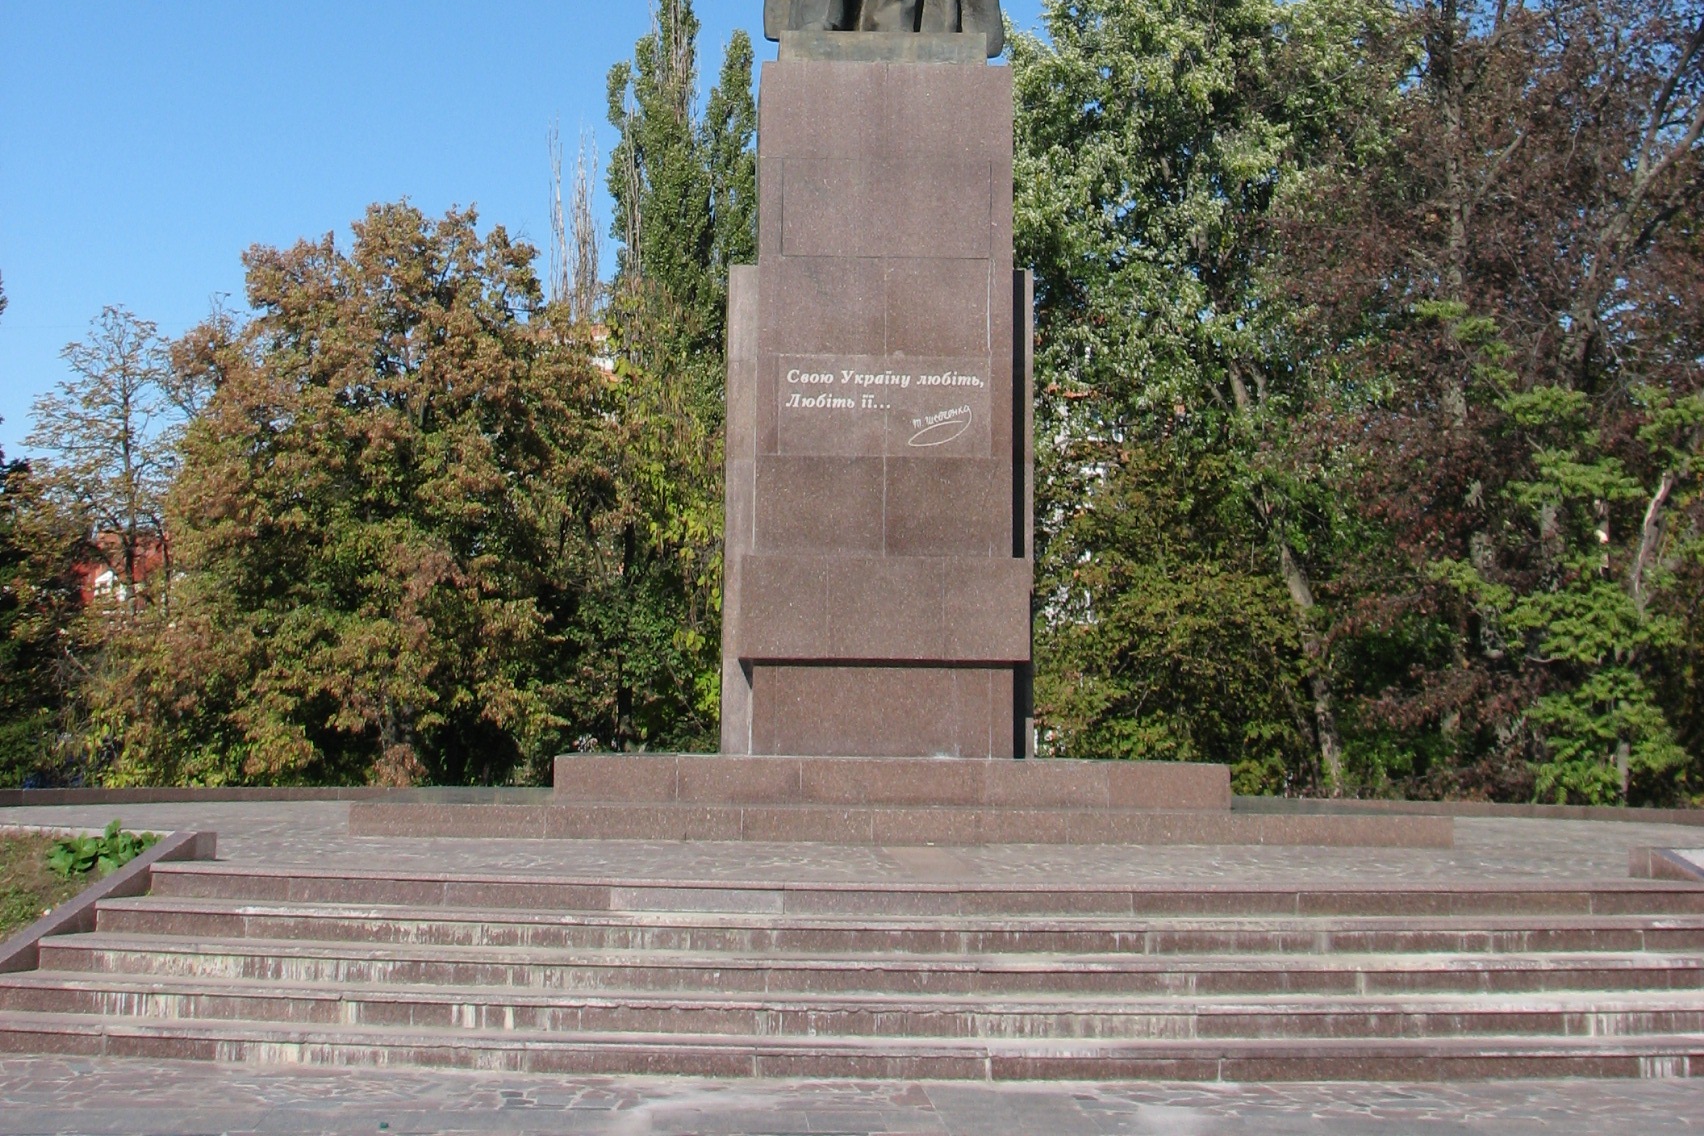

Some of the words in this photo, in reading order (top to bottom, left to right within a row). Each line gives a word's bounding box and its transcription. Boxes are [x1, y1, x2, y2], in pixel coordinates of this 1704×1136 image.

[786, 369, 834, 384] Свою
[841, 370, 911, 388] Україну
[917, 371, 985, 388] любіть,
[785, 394, 855, 409] Любіть
